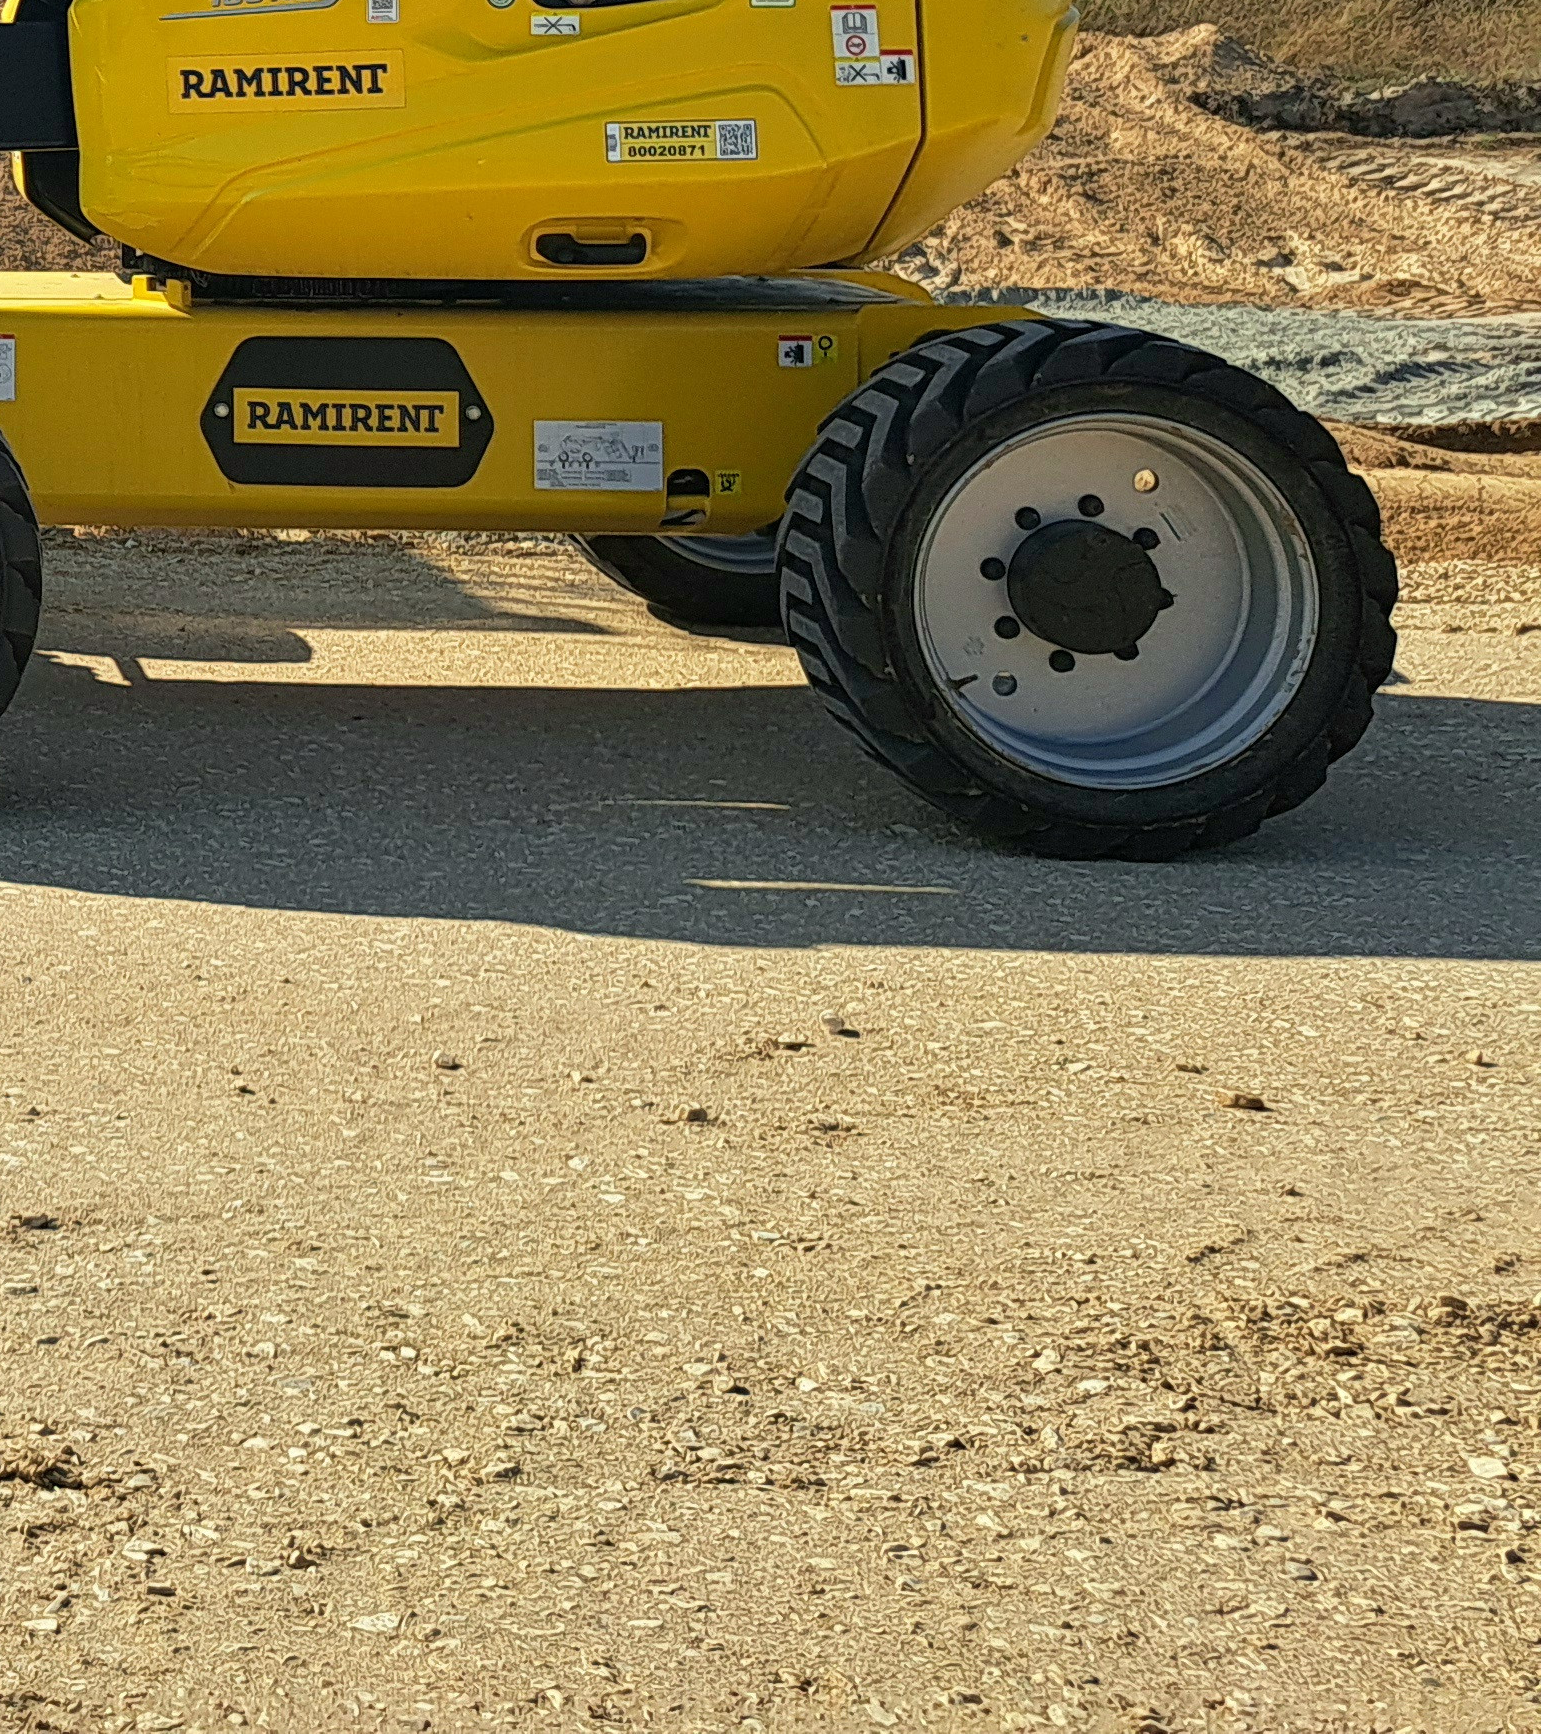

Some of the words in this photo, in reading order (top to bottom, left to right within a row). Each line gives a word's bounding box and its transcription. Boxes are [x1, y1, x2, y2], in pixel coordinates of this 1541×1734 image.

[180, 64, 388, 99] RAMIRENT
[623, 124, 711, 139] RAMIRENT
[627, 145, 706, 157] 80020871
[247, 401, 444, 433] RAMIRENT
